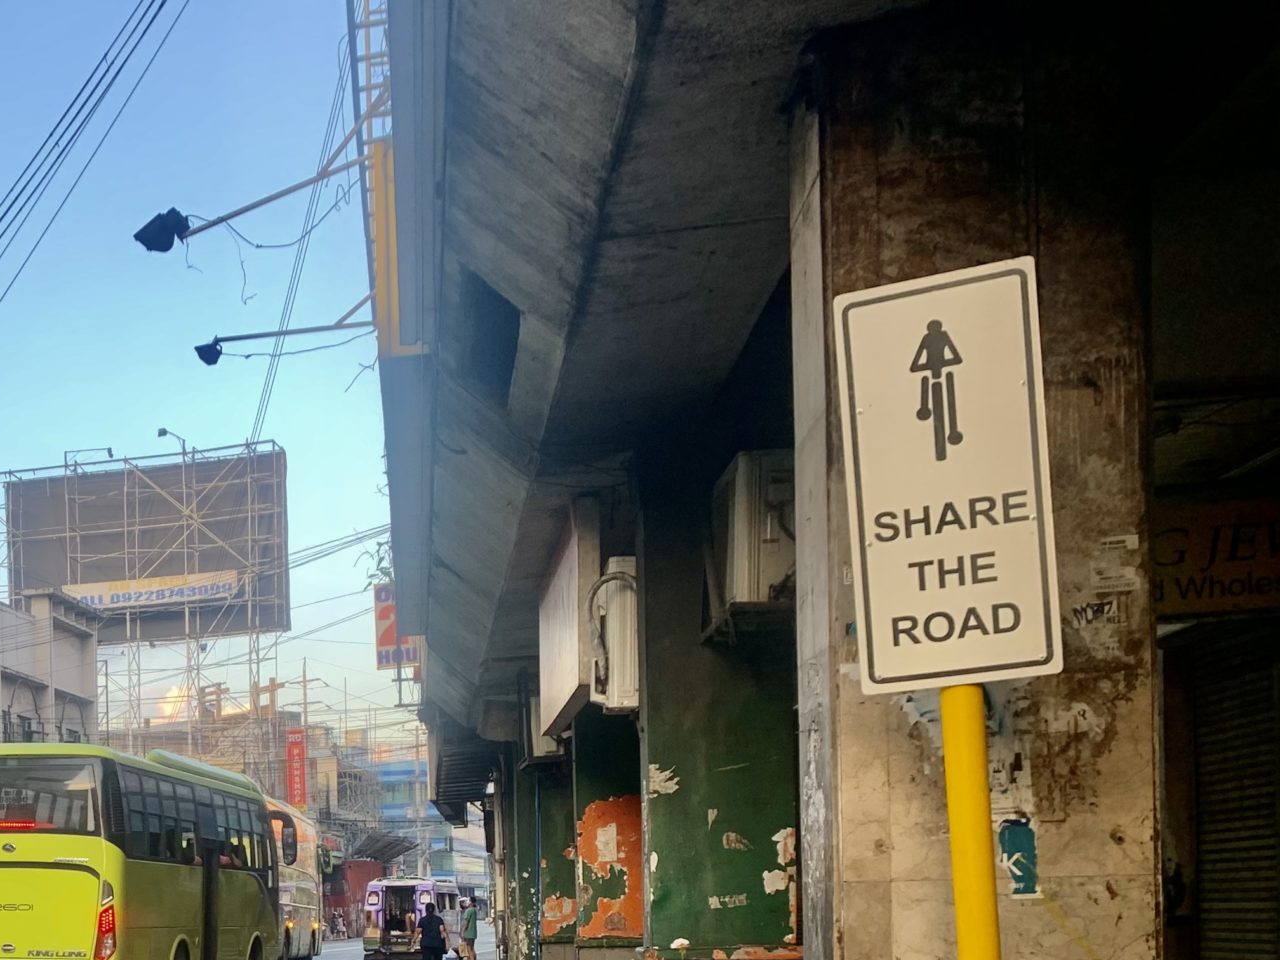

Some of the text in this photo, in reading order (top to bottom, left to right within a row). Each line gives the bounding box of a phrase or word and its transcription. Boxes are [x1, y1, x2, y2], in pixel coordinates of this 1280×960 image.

[874, 489, 1030, 543] SHARE
[908, 550, 998, 592] THE
[891, 602, 1022, 647] ROAD
[27, 949, 54, 957] KING
